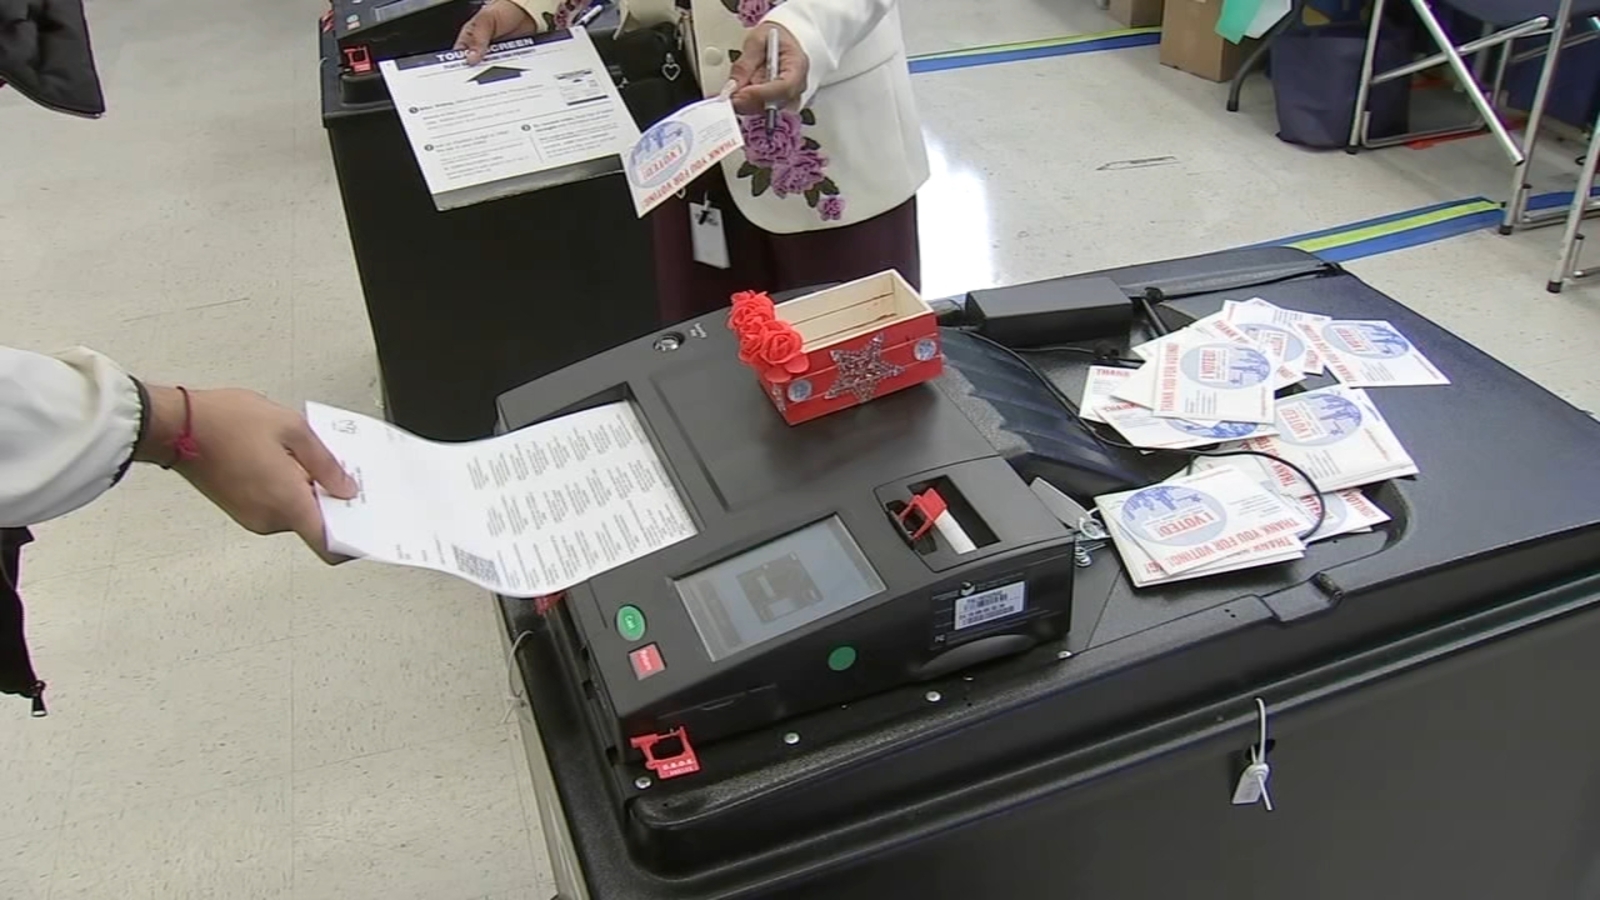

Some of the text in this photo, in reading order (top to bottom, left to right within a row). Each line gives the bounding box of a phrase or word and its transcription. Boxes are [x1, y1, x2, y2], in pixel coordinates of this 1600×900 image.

[708, 138, 737, 159] THANK
[690, 156, 708, 173] YOU
[672, 168, 691, 186] FOR
[1164, 366, 1177, 378] FOR
[1162, 378, 1176, 391] YOU
[1160, 391, 1174, 411] THANK
[1204, 512, 1214, 520] I
[1263, 517, 1301, 535] THANK
[1213, 537, 1238, 550] FOR
[1236, 529, 1262, 544] YOU
